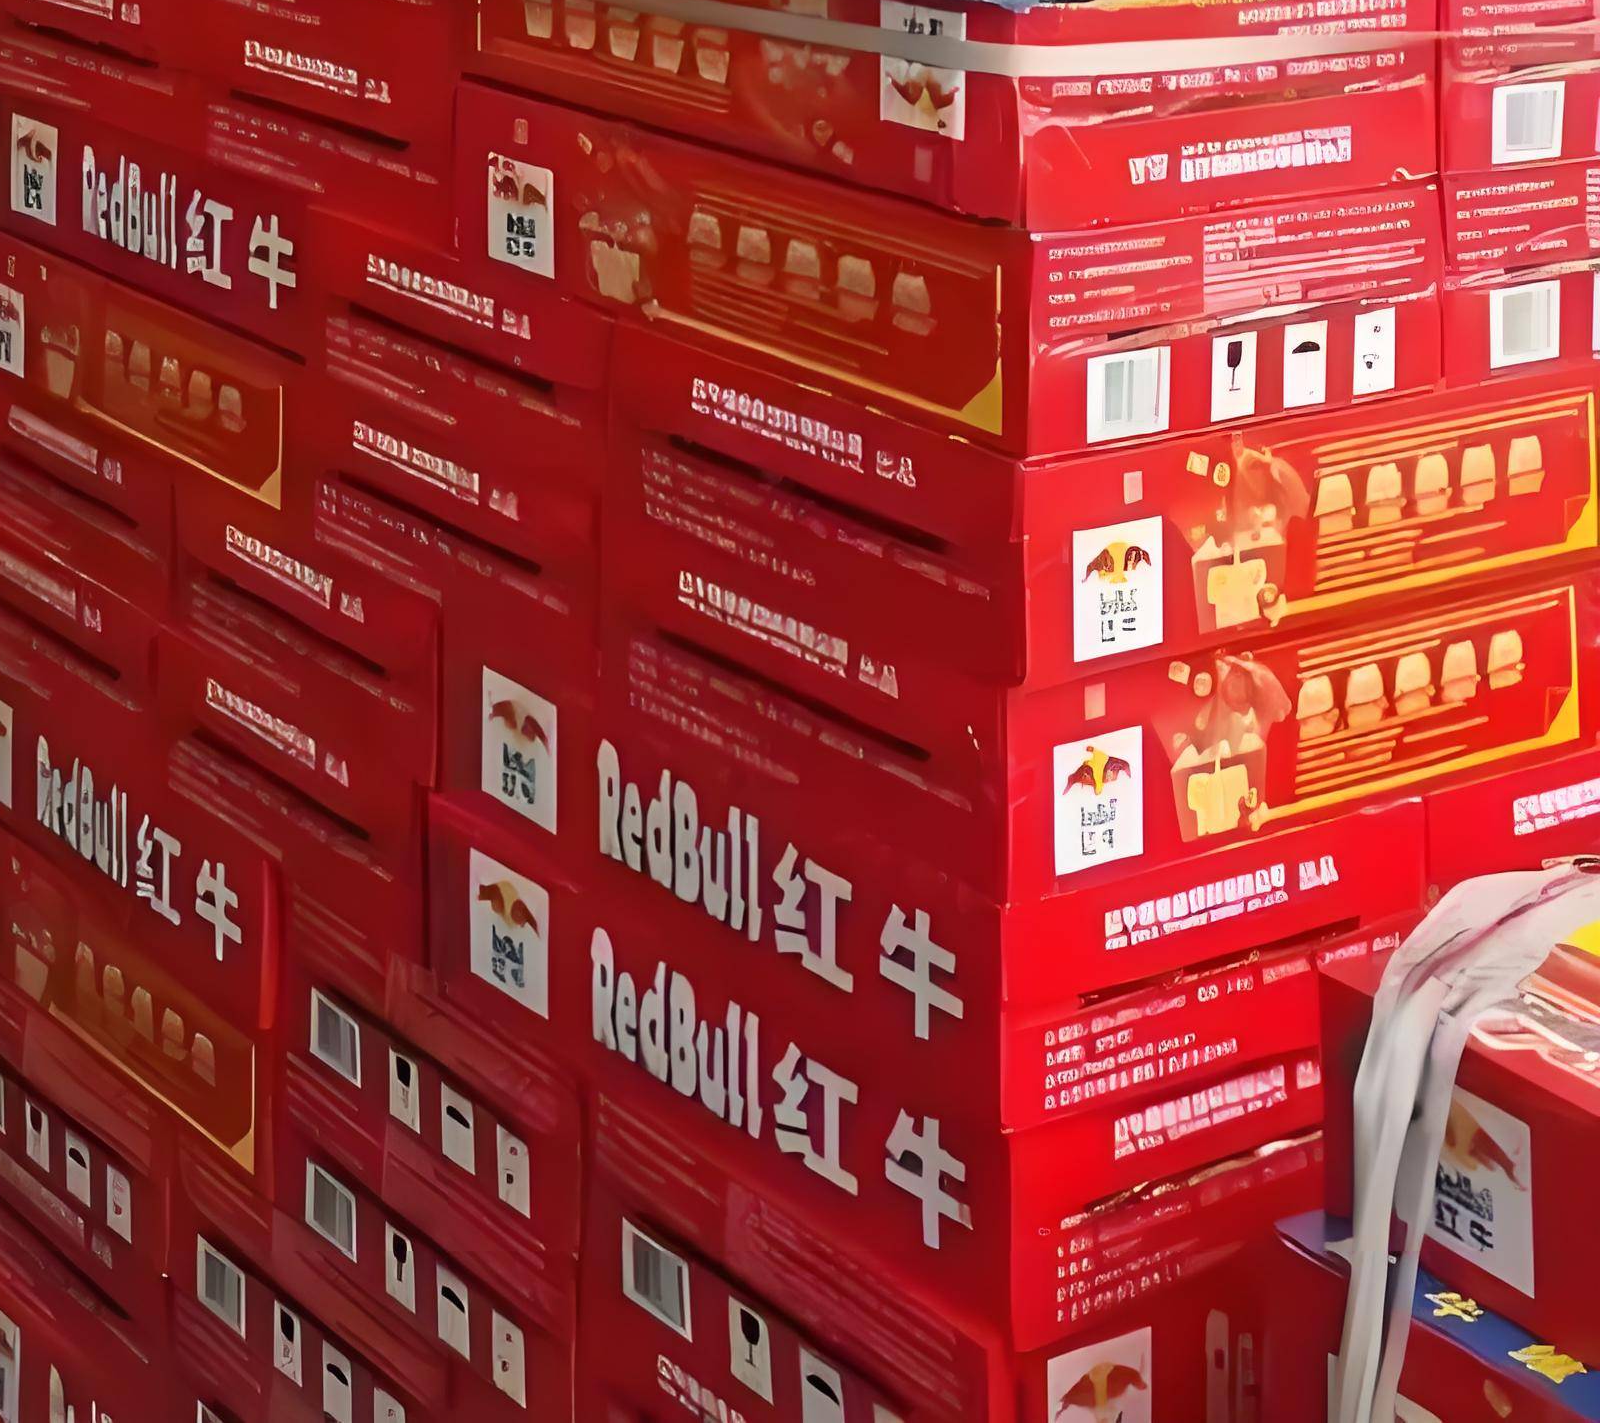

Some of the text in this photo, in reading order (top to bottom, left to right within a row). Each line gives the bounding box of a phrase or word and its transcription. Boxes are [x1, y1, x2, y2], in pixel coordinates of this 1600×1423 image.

[596, 738, 763, 942] RedBull
[773, 843, 963, 1040] 红牛
[590, 926, 763, 1139] RedBull
[772, 1042, 973, 1249] 红牛
